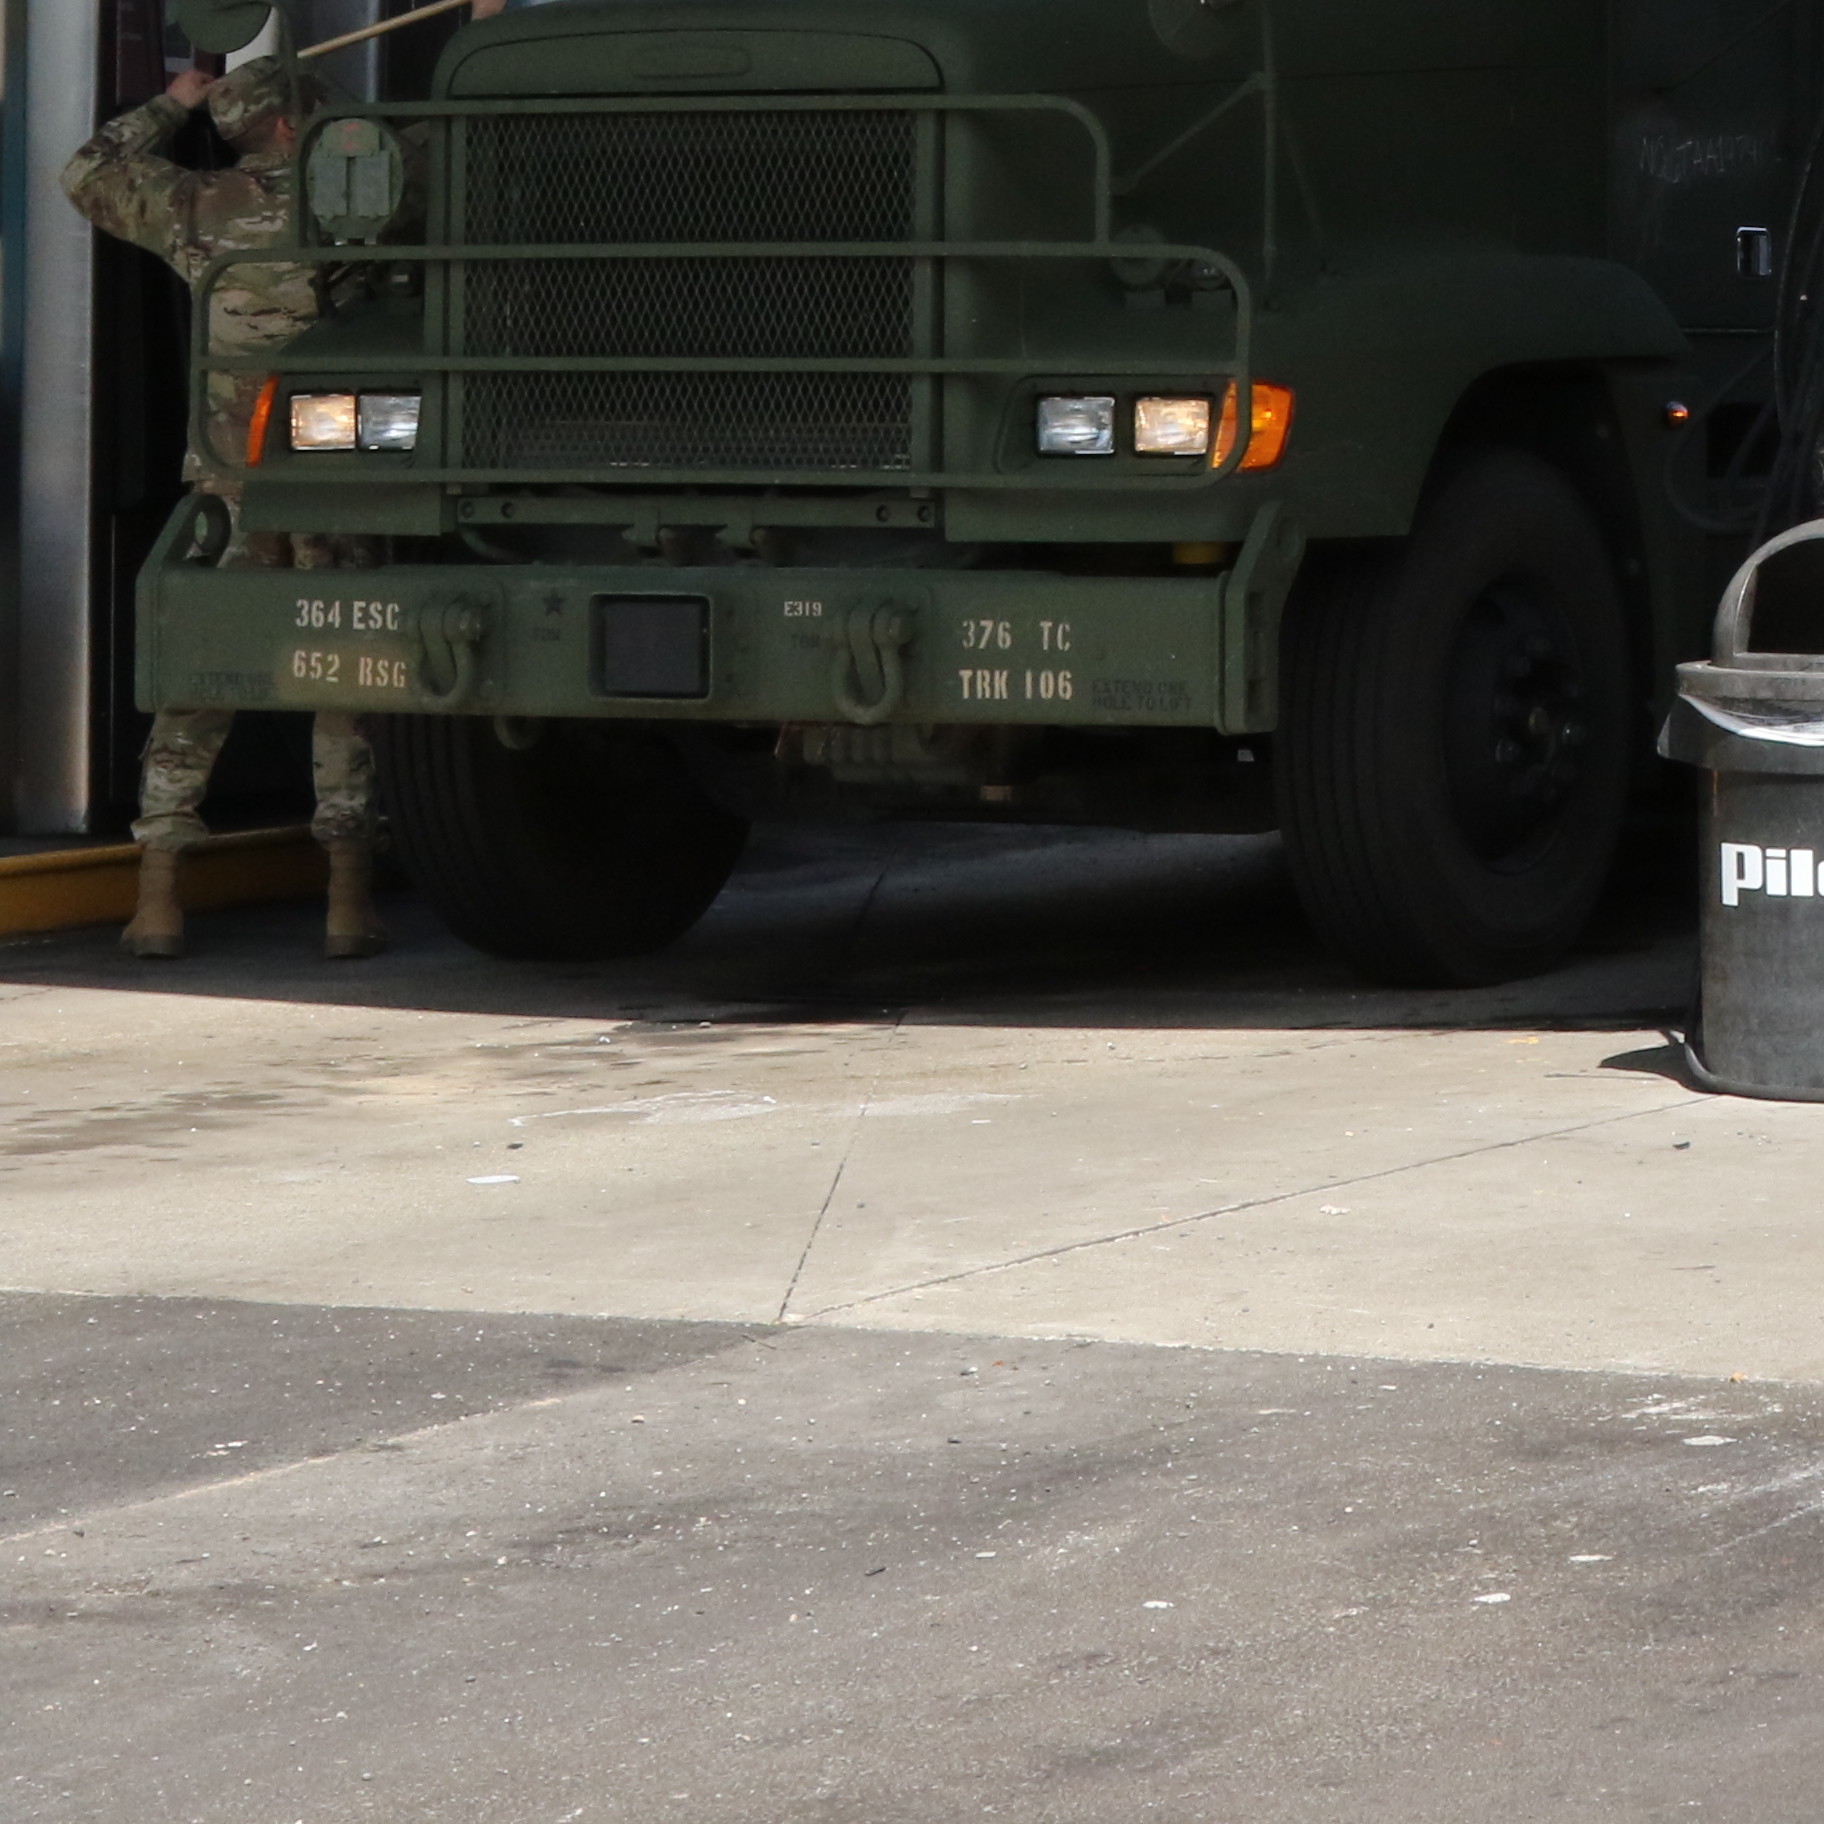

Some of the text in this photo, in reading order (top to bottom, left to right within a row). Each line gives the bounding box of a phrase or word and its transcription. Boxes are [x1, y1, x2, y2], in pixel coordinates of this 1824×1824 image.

[295, 598, 401, 632] 364 ESC
[961, 618, 1073, 652] 376 TC
[293, 649, 408, 689] 652 RSG
[958, 668, 1073, 701] TRK 106
